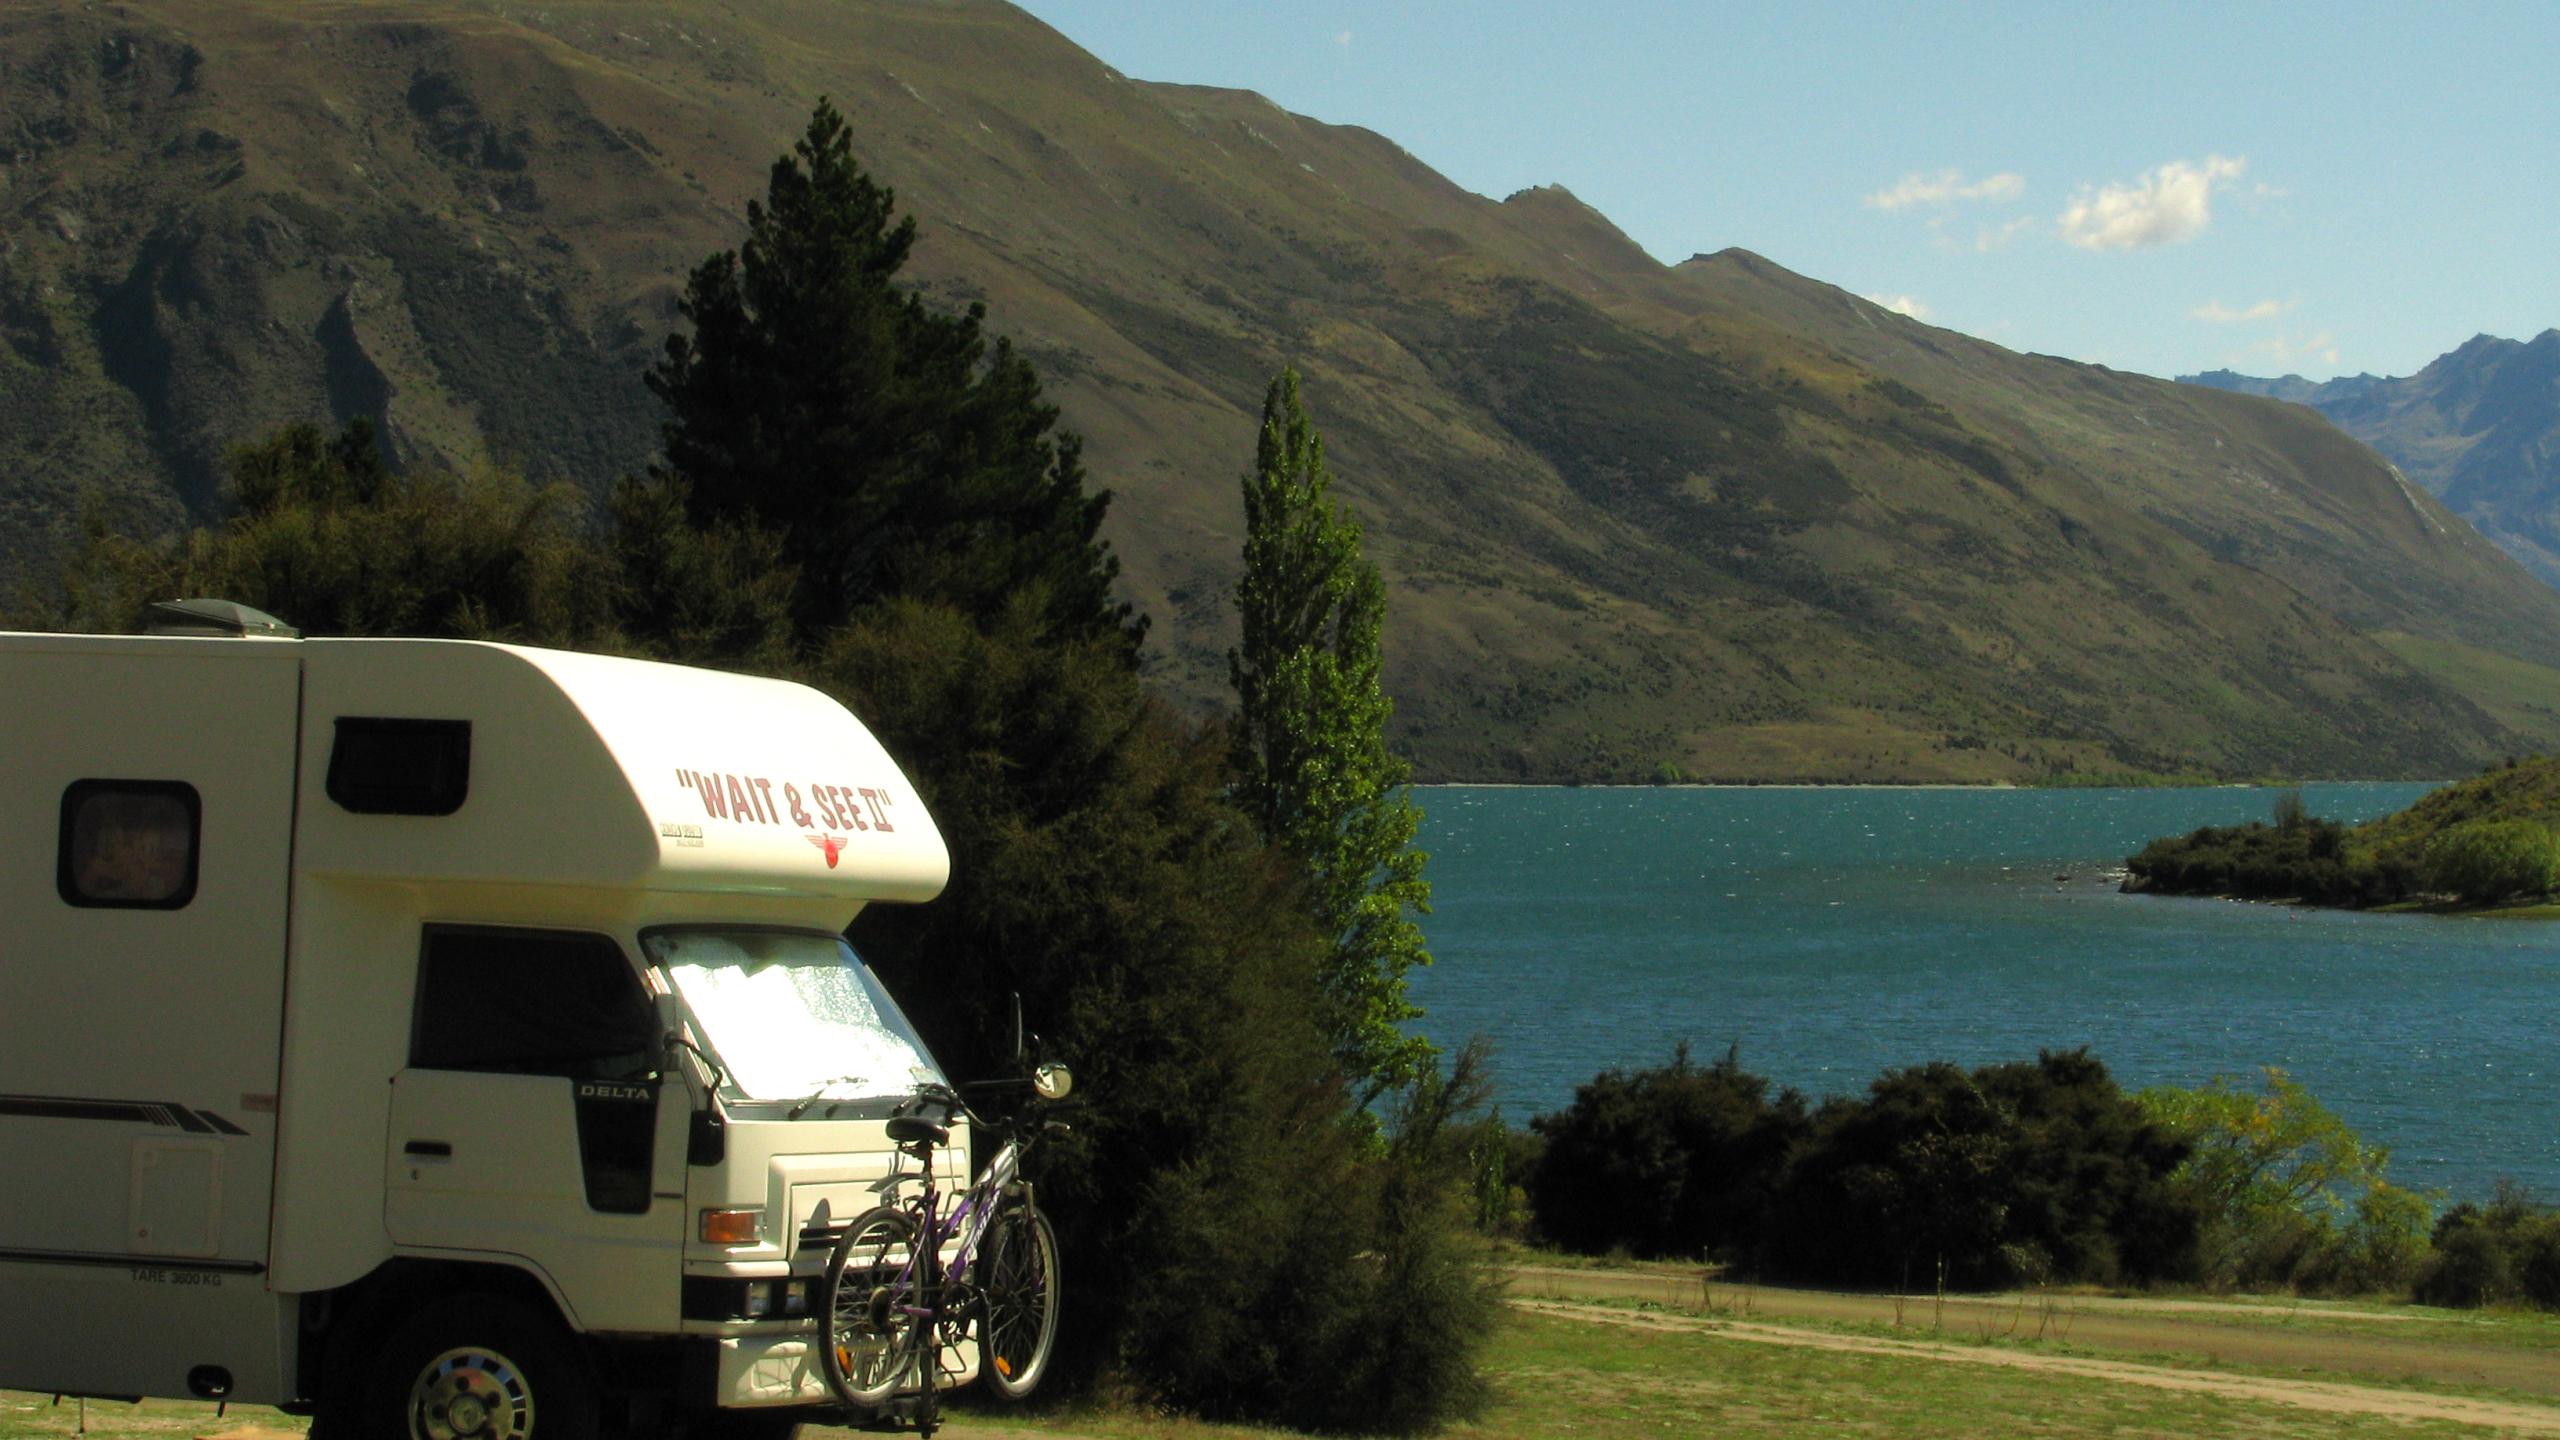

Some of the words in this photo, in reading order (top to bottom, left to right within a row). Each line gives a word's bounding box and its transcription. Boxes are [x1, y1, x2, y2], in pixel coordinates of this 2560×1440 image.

[676, 768, 779, 825] "WAIT
[784, 782, 813, 829] &
[812, 784, 868, 831] SEE
[581, 1085, 649, 1099] DELTA
[131, 1269, 165, 1283] TARE
[203, 1272, 222, 1286] KG
